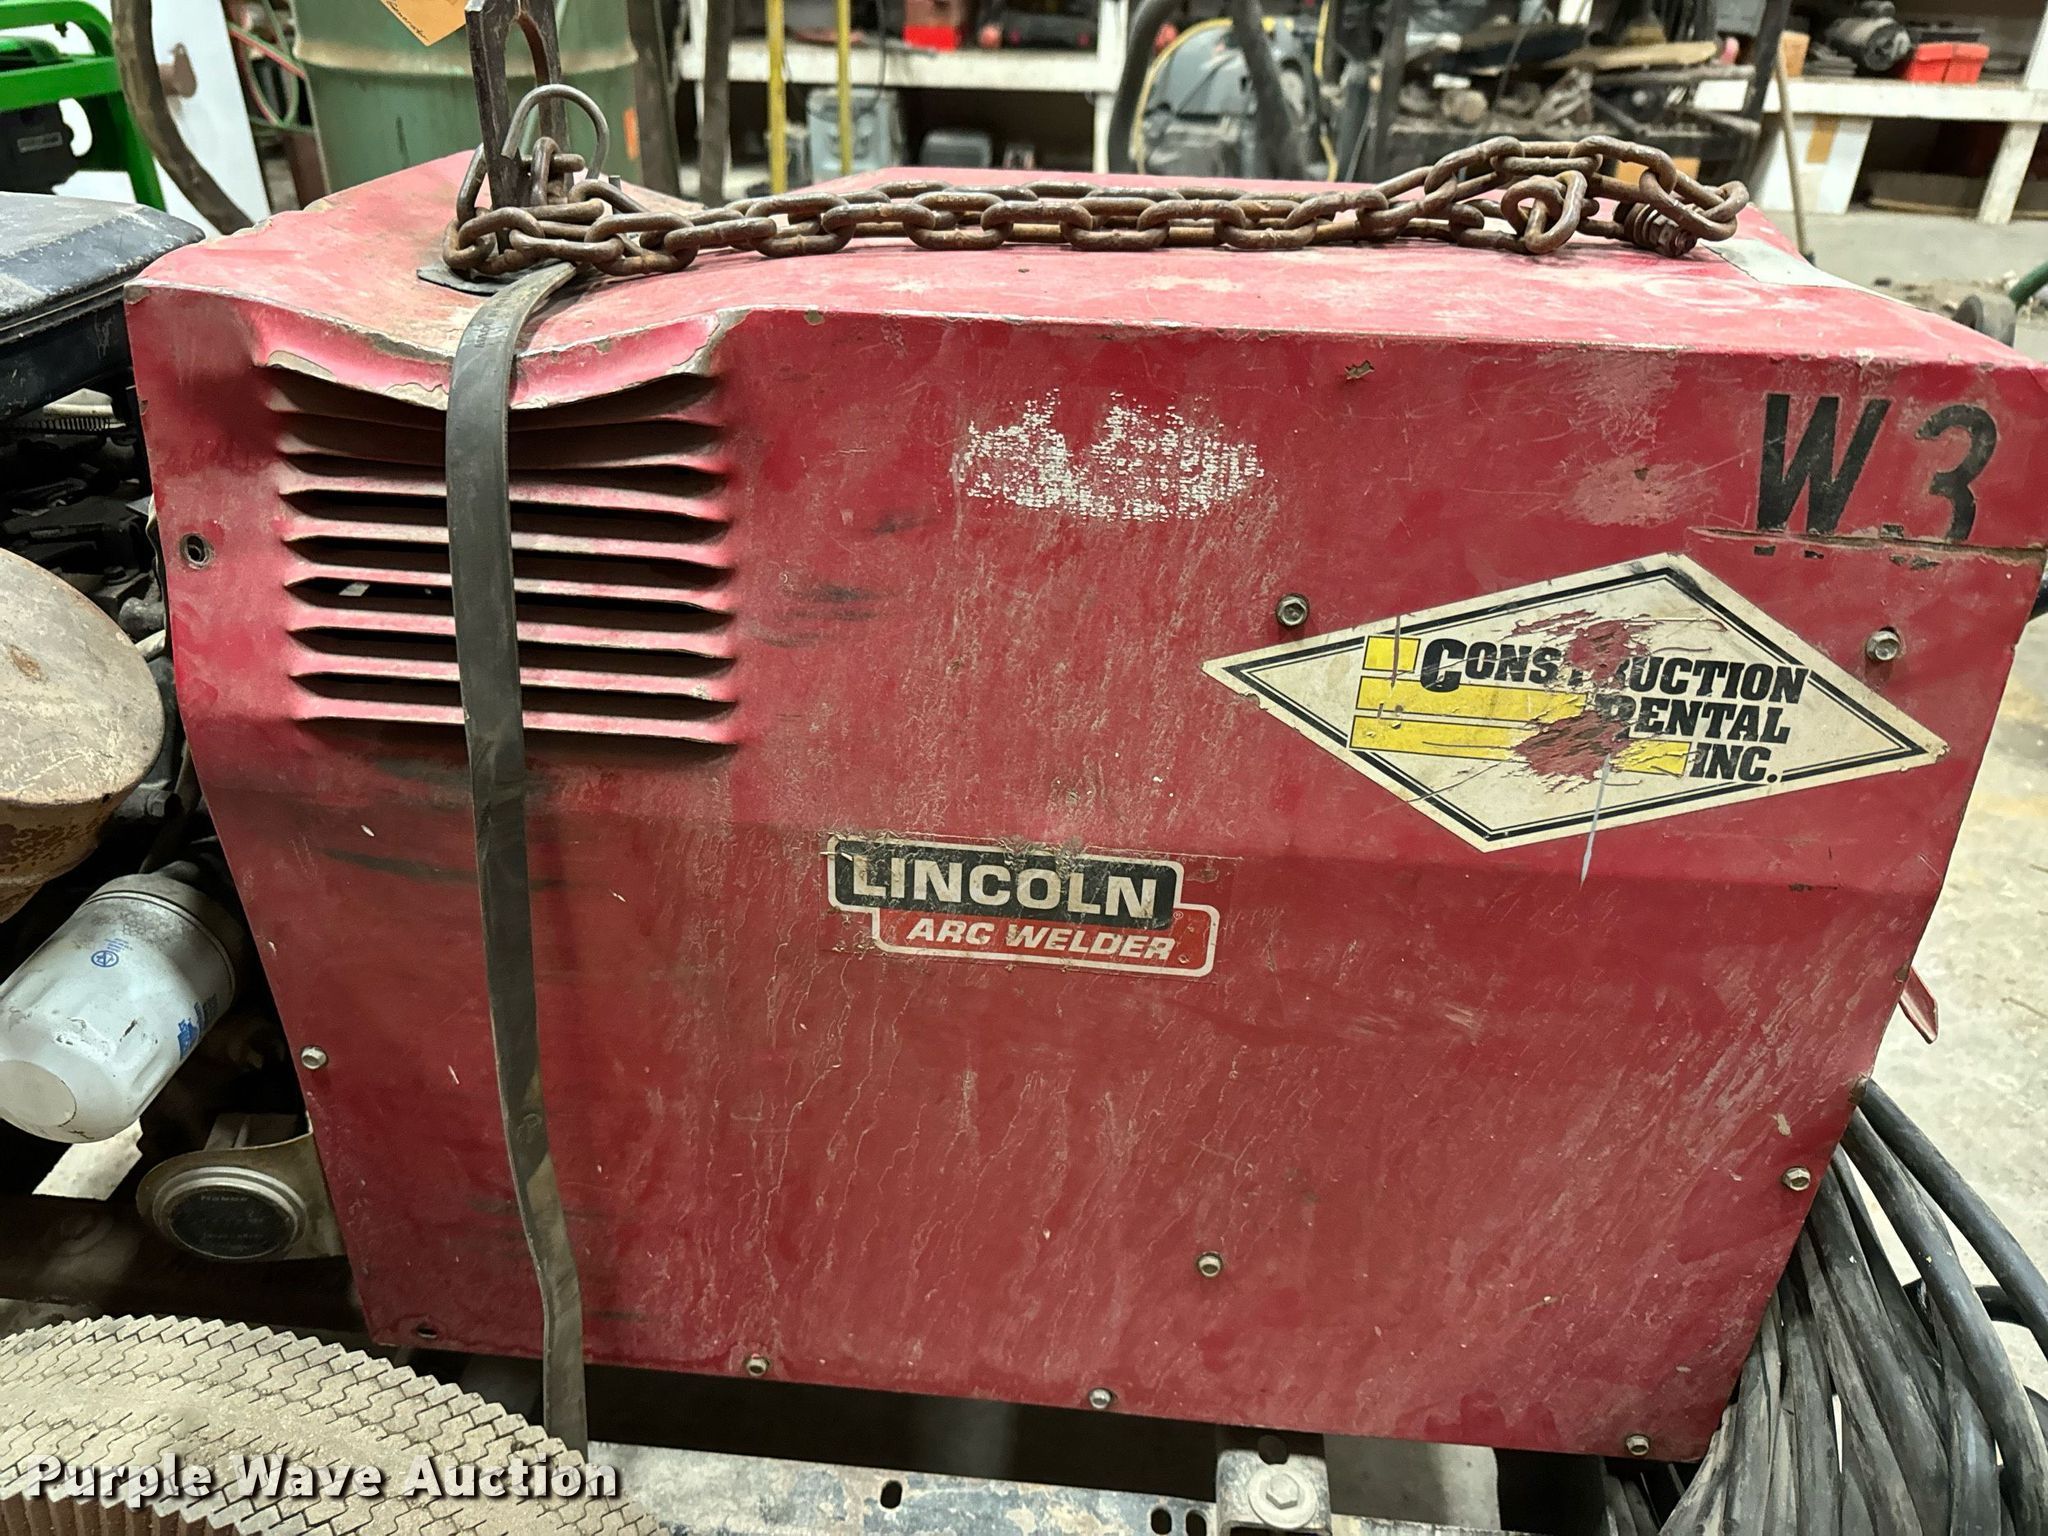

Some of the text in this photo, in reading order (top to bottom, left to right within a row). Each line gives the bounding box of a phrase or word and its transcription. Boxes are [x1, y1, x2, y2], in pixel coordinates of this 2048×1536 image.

[1420, 637, 1809, 704] CONSUCTION
[1688, 741, 1783, 783] INC.
[851, 854, 1158, 919] LINCOLN
[906, 919, 1176, 961] ARC WELDER
